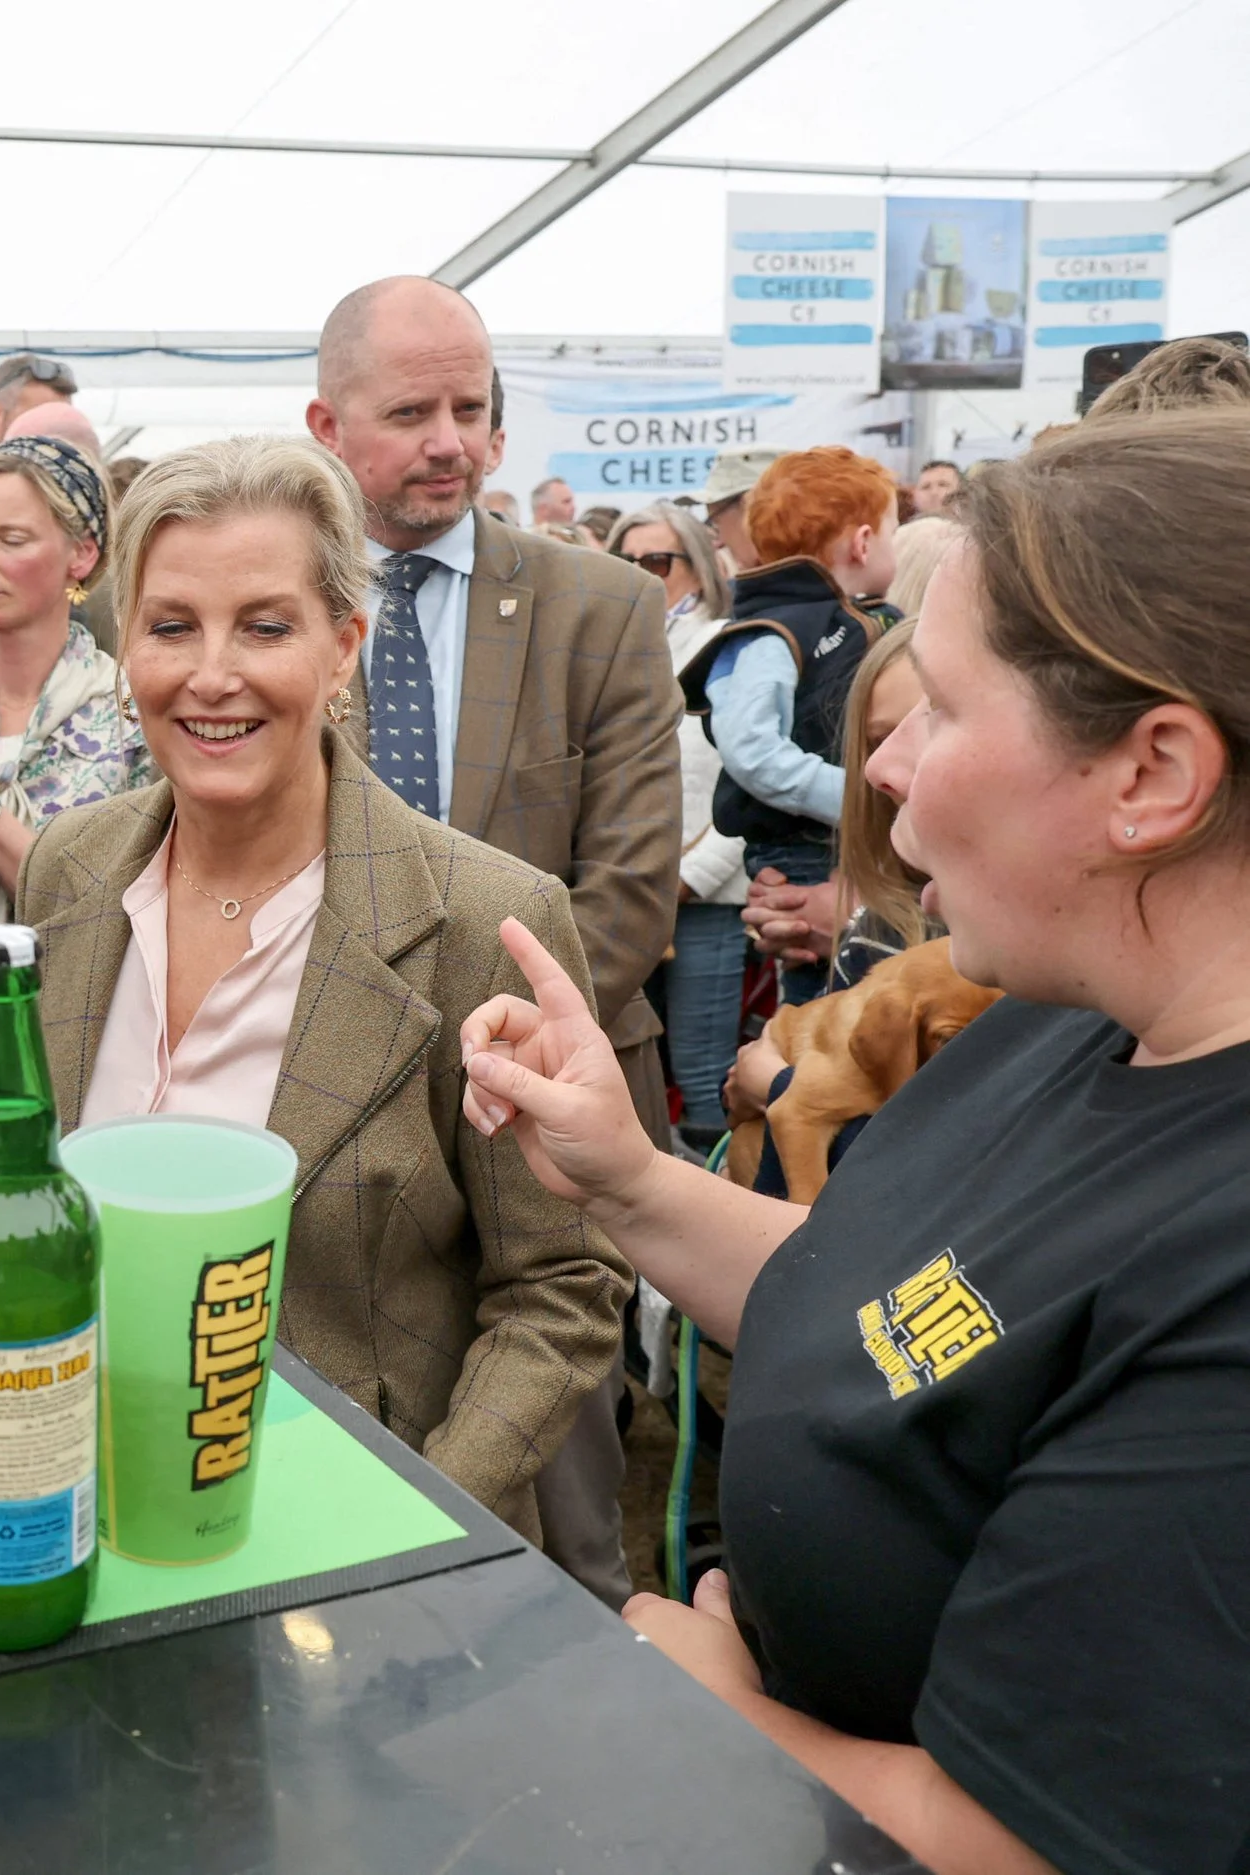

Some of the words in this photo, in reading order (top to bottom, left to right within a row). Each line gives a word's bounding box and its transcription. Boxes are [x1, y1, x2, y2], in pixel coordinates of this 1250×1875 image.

[753, 254, 855, 273] CORNISH
[1055, 258, 1149, 276] CORNISH
[760, 279, 845, 299] CHEESE
[586, 416, 758, 446] CORNISH
[601, 457, 715, 486] CHEES
[188, 1239, 275, 1491] RATTLER
